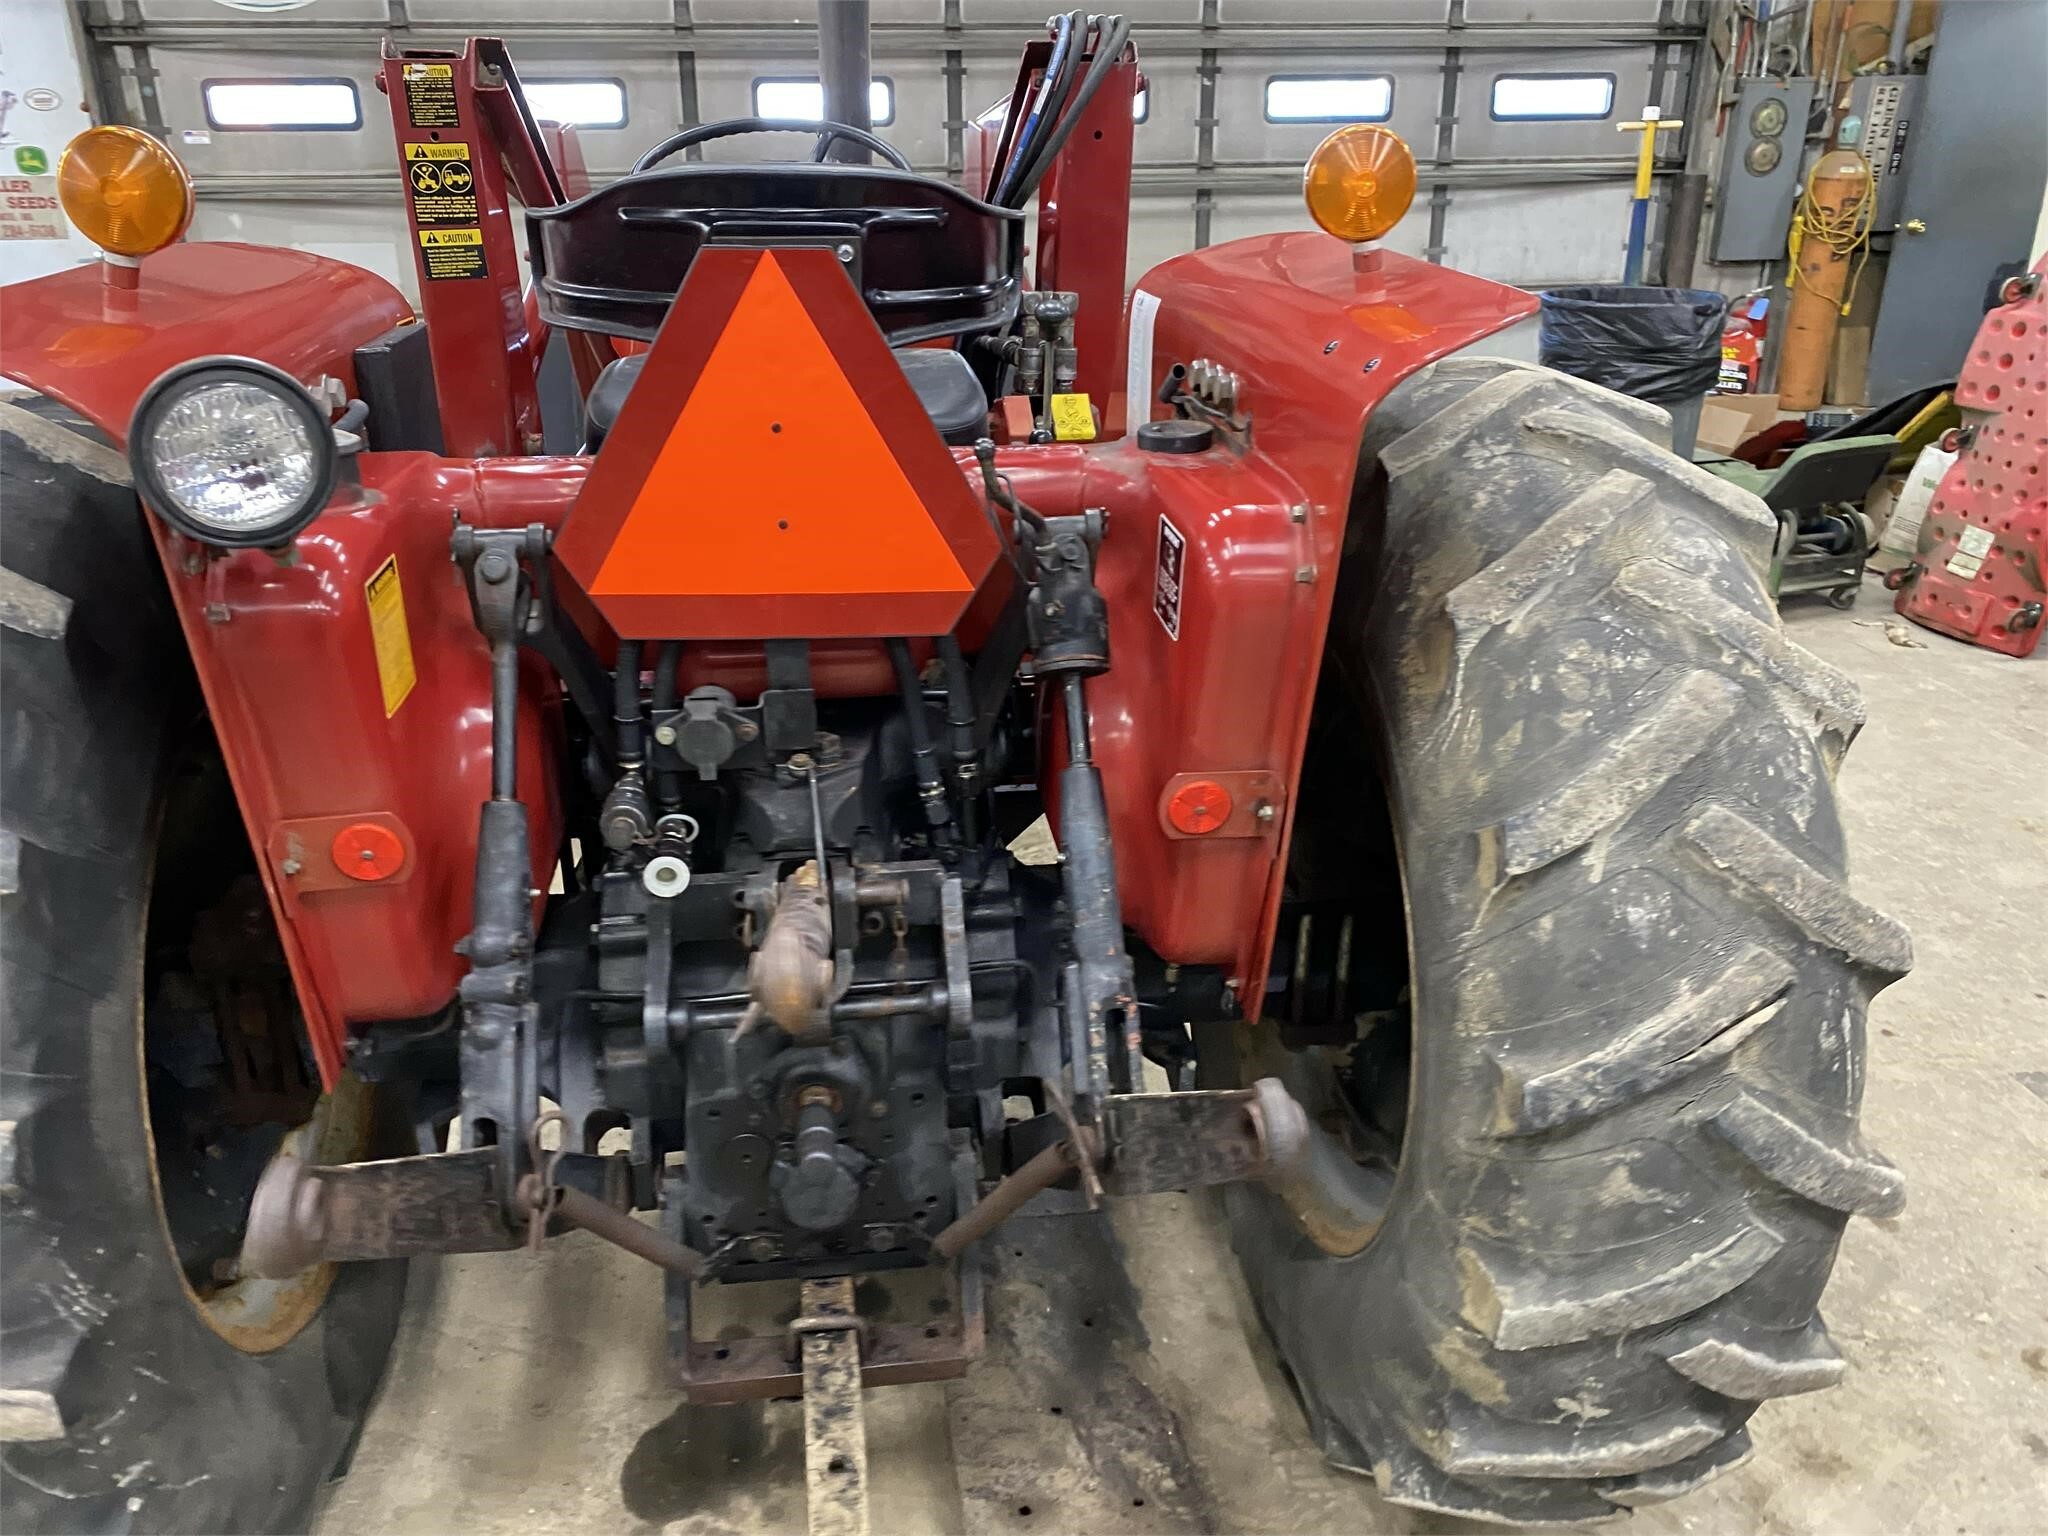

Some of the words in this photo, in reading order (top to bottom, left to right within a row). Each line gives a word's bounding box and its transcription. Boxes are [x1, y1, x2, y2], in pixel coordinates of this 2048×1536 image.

[430, 148, 465, 158] WARNING
[7, 196, 58, 209] SEEDS
[442, 233, 474, 244] CAUTION
